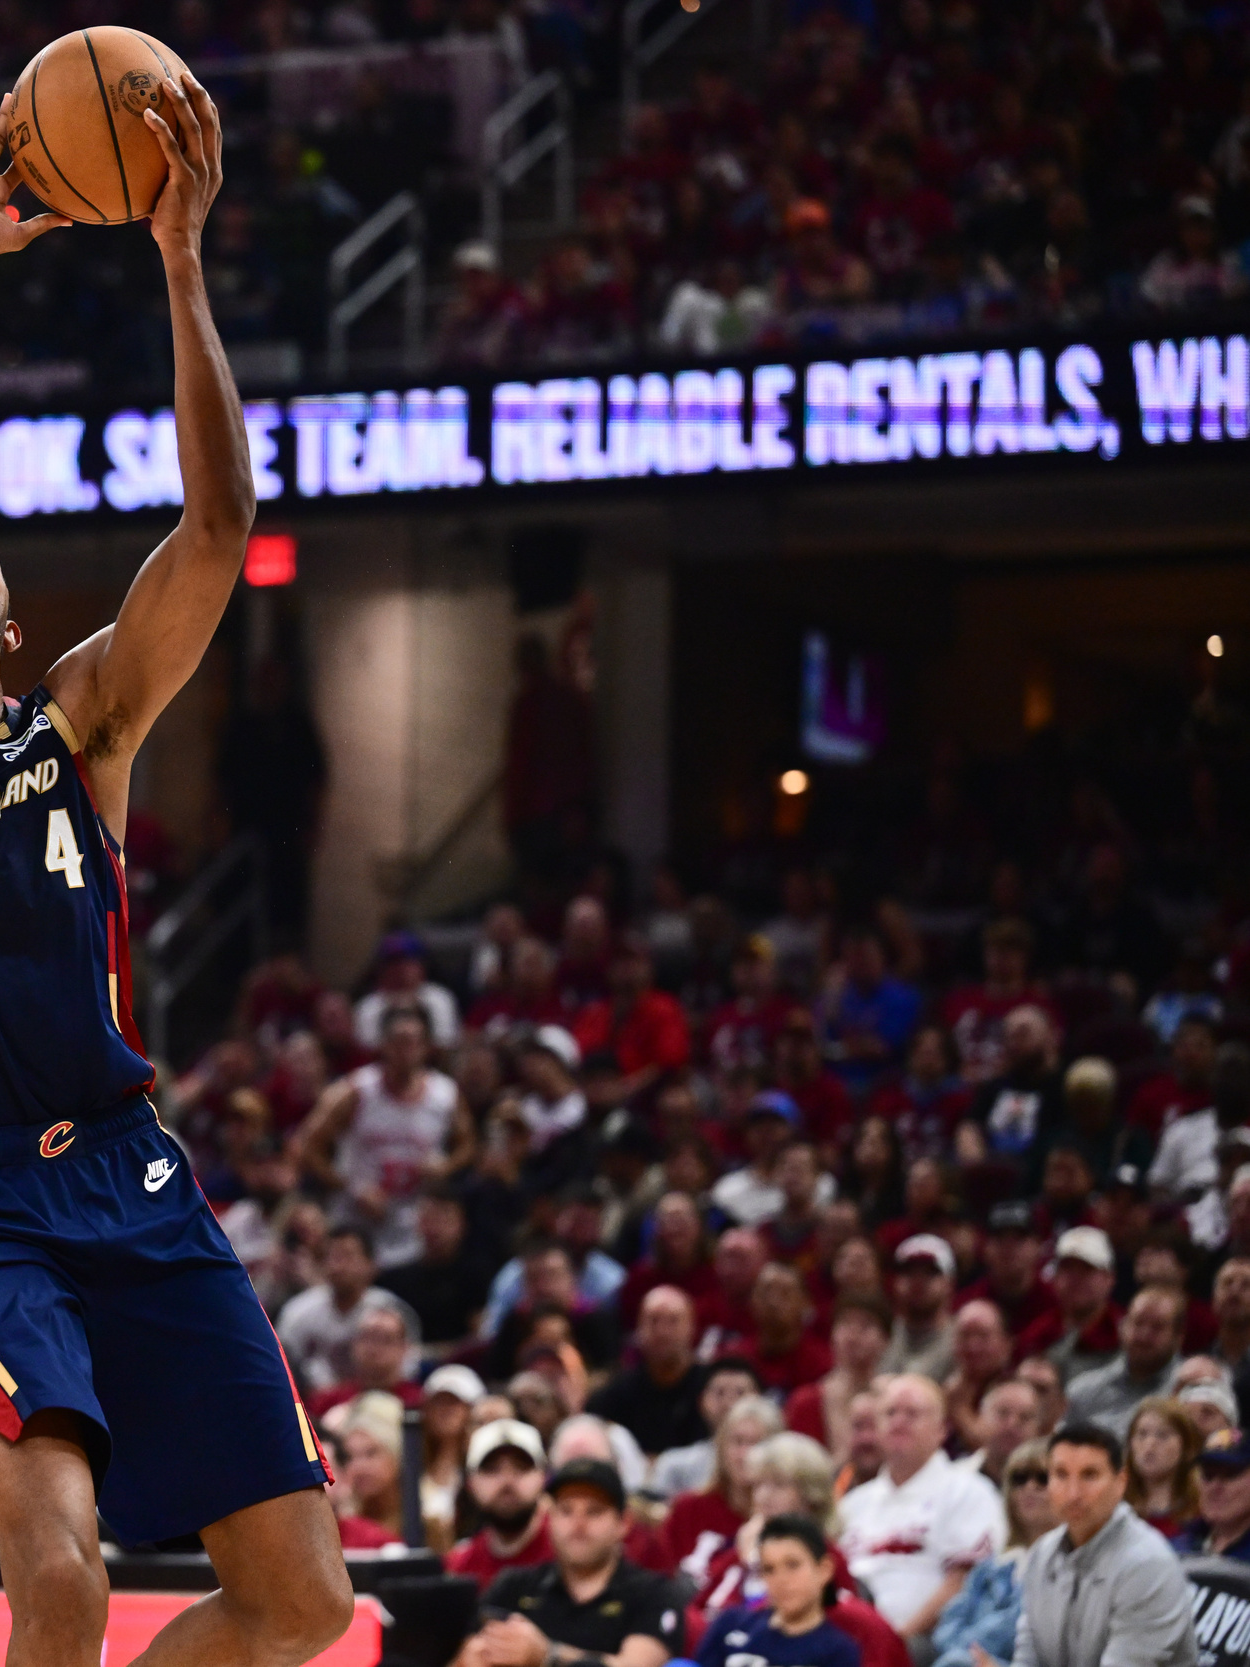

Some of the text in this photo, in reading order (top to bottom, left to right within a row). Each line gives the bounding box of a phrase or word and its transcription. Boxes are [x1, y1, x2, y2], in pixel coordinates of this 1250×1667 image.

[103, 397, 284, 512] SAE
[287, 386, 485, 498] TEAM.
[491, 365, 796, 485] RELIABLE
[803, 344, 1121, 467] RENTALS,
[45, 807, 85, 889] 4
[146, 1157, 170, 1181] NIKE
